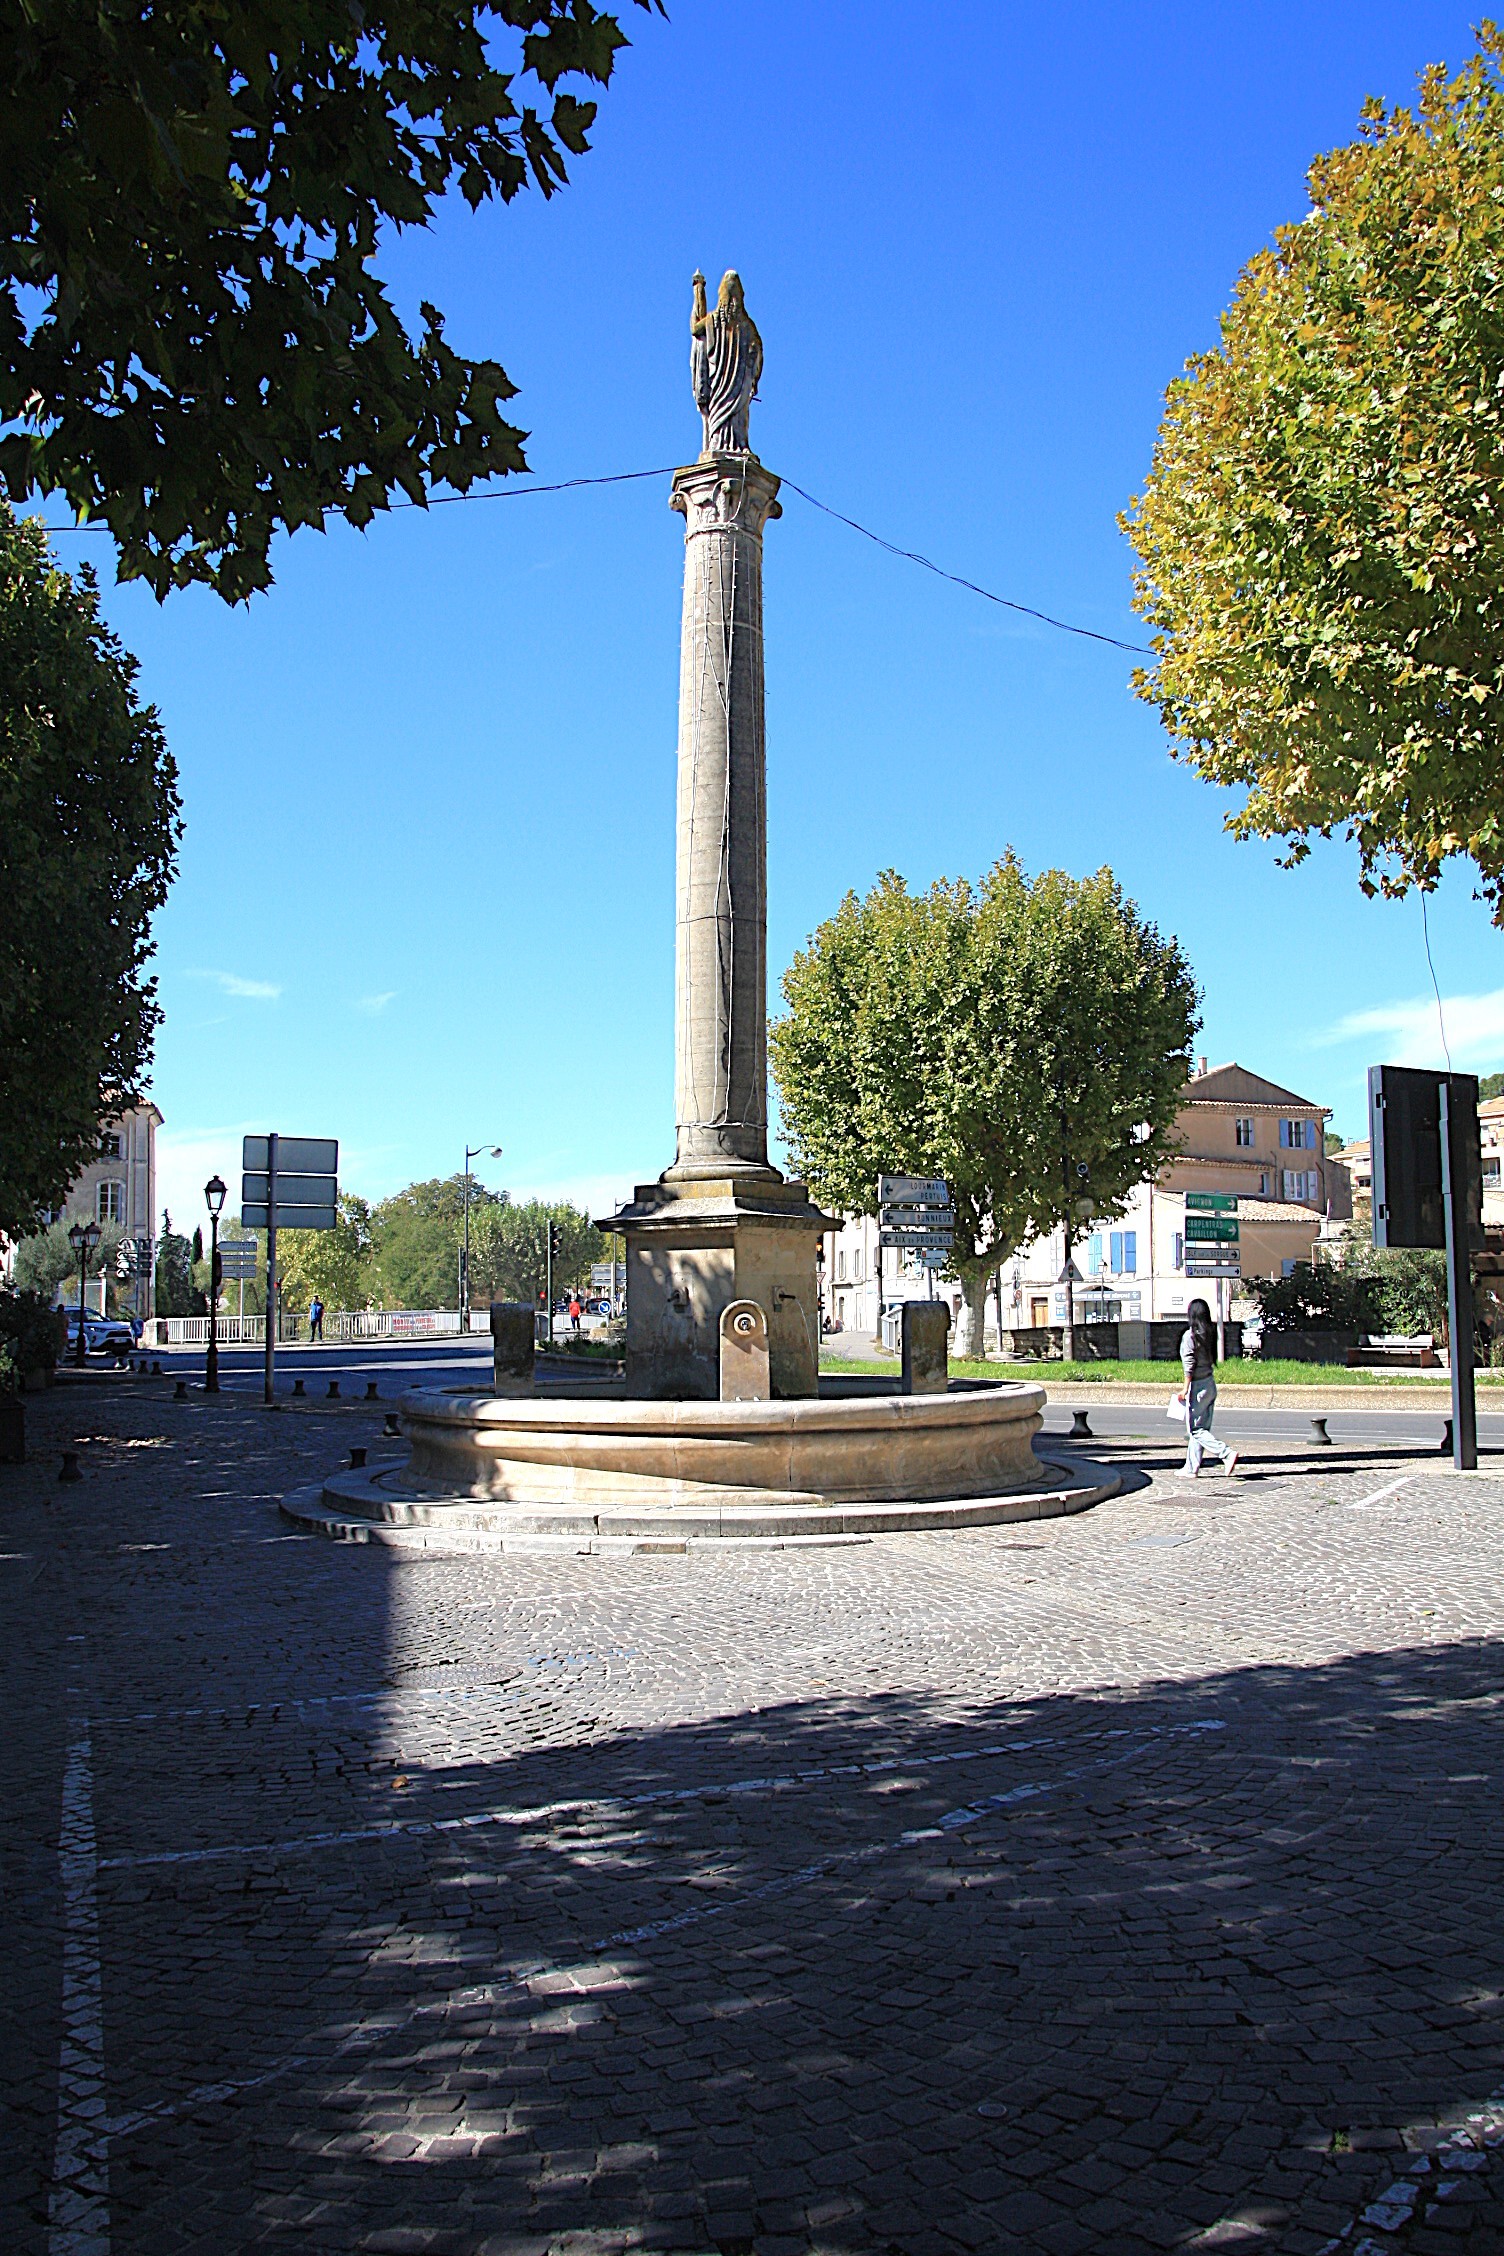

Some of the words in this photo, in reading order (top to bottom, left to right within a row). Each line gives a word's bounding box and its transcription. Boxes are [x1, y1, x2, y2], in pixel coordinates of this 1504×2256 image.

[911, 1182, 945, 1191] LOURMARIN
[920, 1192, 947, 1201] PERTUIS
[1187, 1197, 1212, 1206] AVIGNON
[917, 1214, 951, 1222] BONNIEUX
[1186, 1219, 1223, 1229] CARPENTRAS
[1186, 1229, 1217, 1238] CAVAILLON
[894, 1235, 906, 1243] AIX
[916, 1235, 951, 1244] PROVENCE
[1194, 1267, 1213, 1276] Parkings
